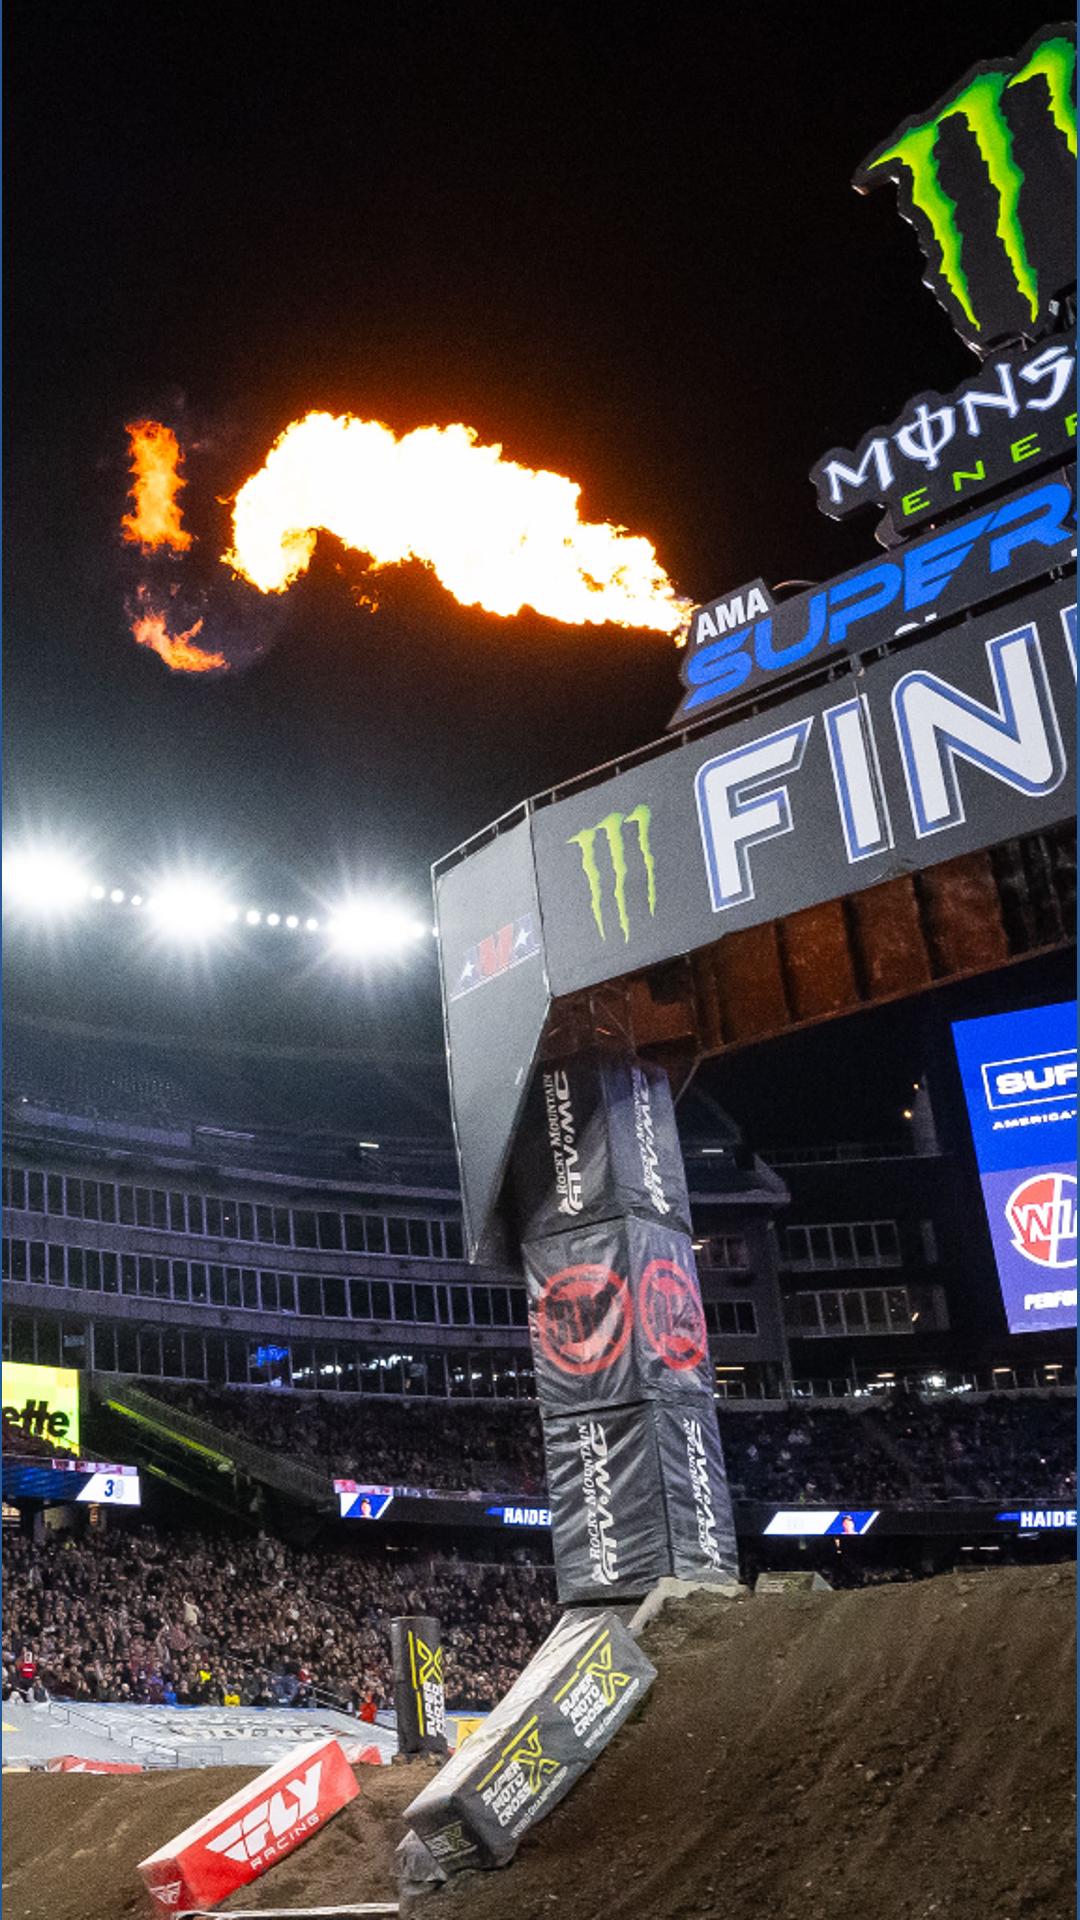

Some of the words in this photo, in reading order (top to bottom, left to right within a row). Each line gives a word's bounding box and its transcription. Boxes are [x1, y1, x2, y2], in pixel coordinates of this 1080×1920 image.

[696, 587, 769, 644] AMA
[543, 1074, 562, 1147] MOUNTAIN
[554, 1150, 568, 1194] ROCKY
[577, 1422, 597, 1505] MOUNTAIN
[588, 1508, 601, 1559] ROCKY
[559, 1672, 595, 1717] SUPER
[570, 1684, 600, 1724] MOTO
[574, 1693, 607, 1737] CROSS
[481, 1761, 521, 1807] SUPER
[492, 1771, 525, 1815] MOTO
[498, 1780, 533, 1827] CROSS
[205, 1760, 323, 1863] FLY
[250, 1813, 320, 1870] RACING
